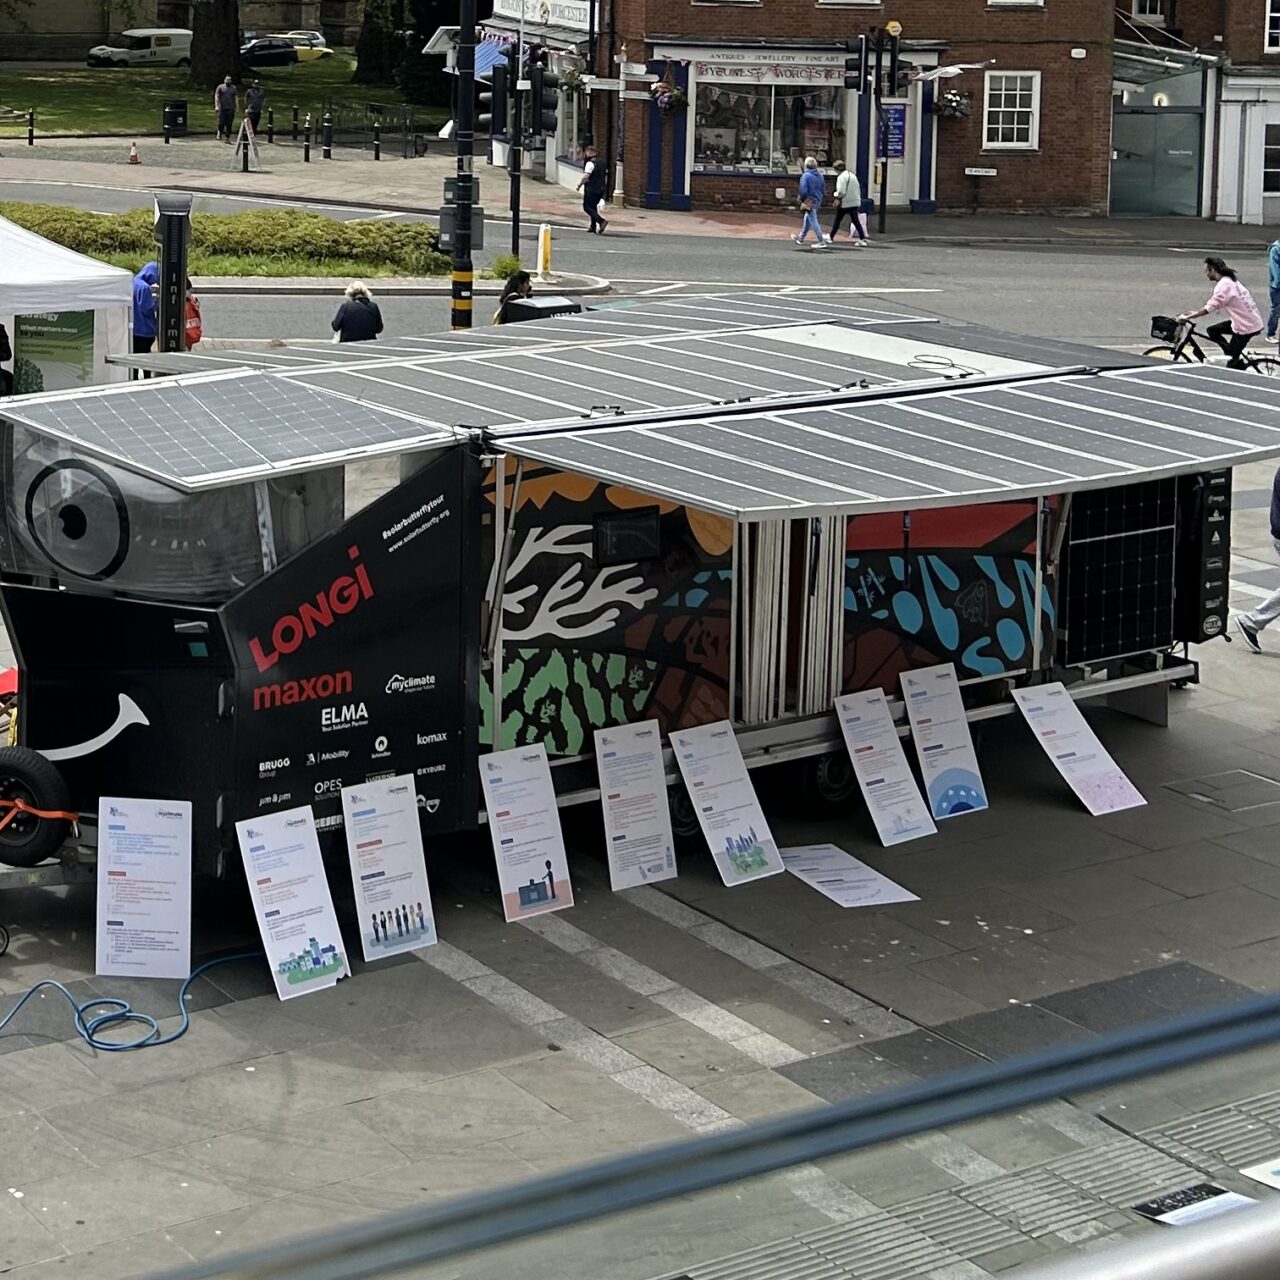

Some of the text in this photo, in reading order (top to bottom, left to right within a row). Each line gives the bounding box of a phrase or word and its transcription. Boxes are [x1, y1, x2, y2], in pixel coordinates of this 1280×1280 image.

[382, 494, 445, 540] #solarbutterflytour
[253, 670, 353, 711] maxon
[391, 674, 436, 693] myclimate
[321, 702, 368, 725] ELMA
[416, 732, 448, 746] komax
[259, 757, 290, 771] BRUGG
[321, 750, 350, 761] Mobility
[314, 778, 343, 794] OPES
